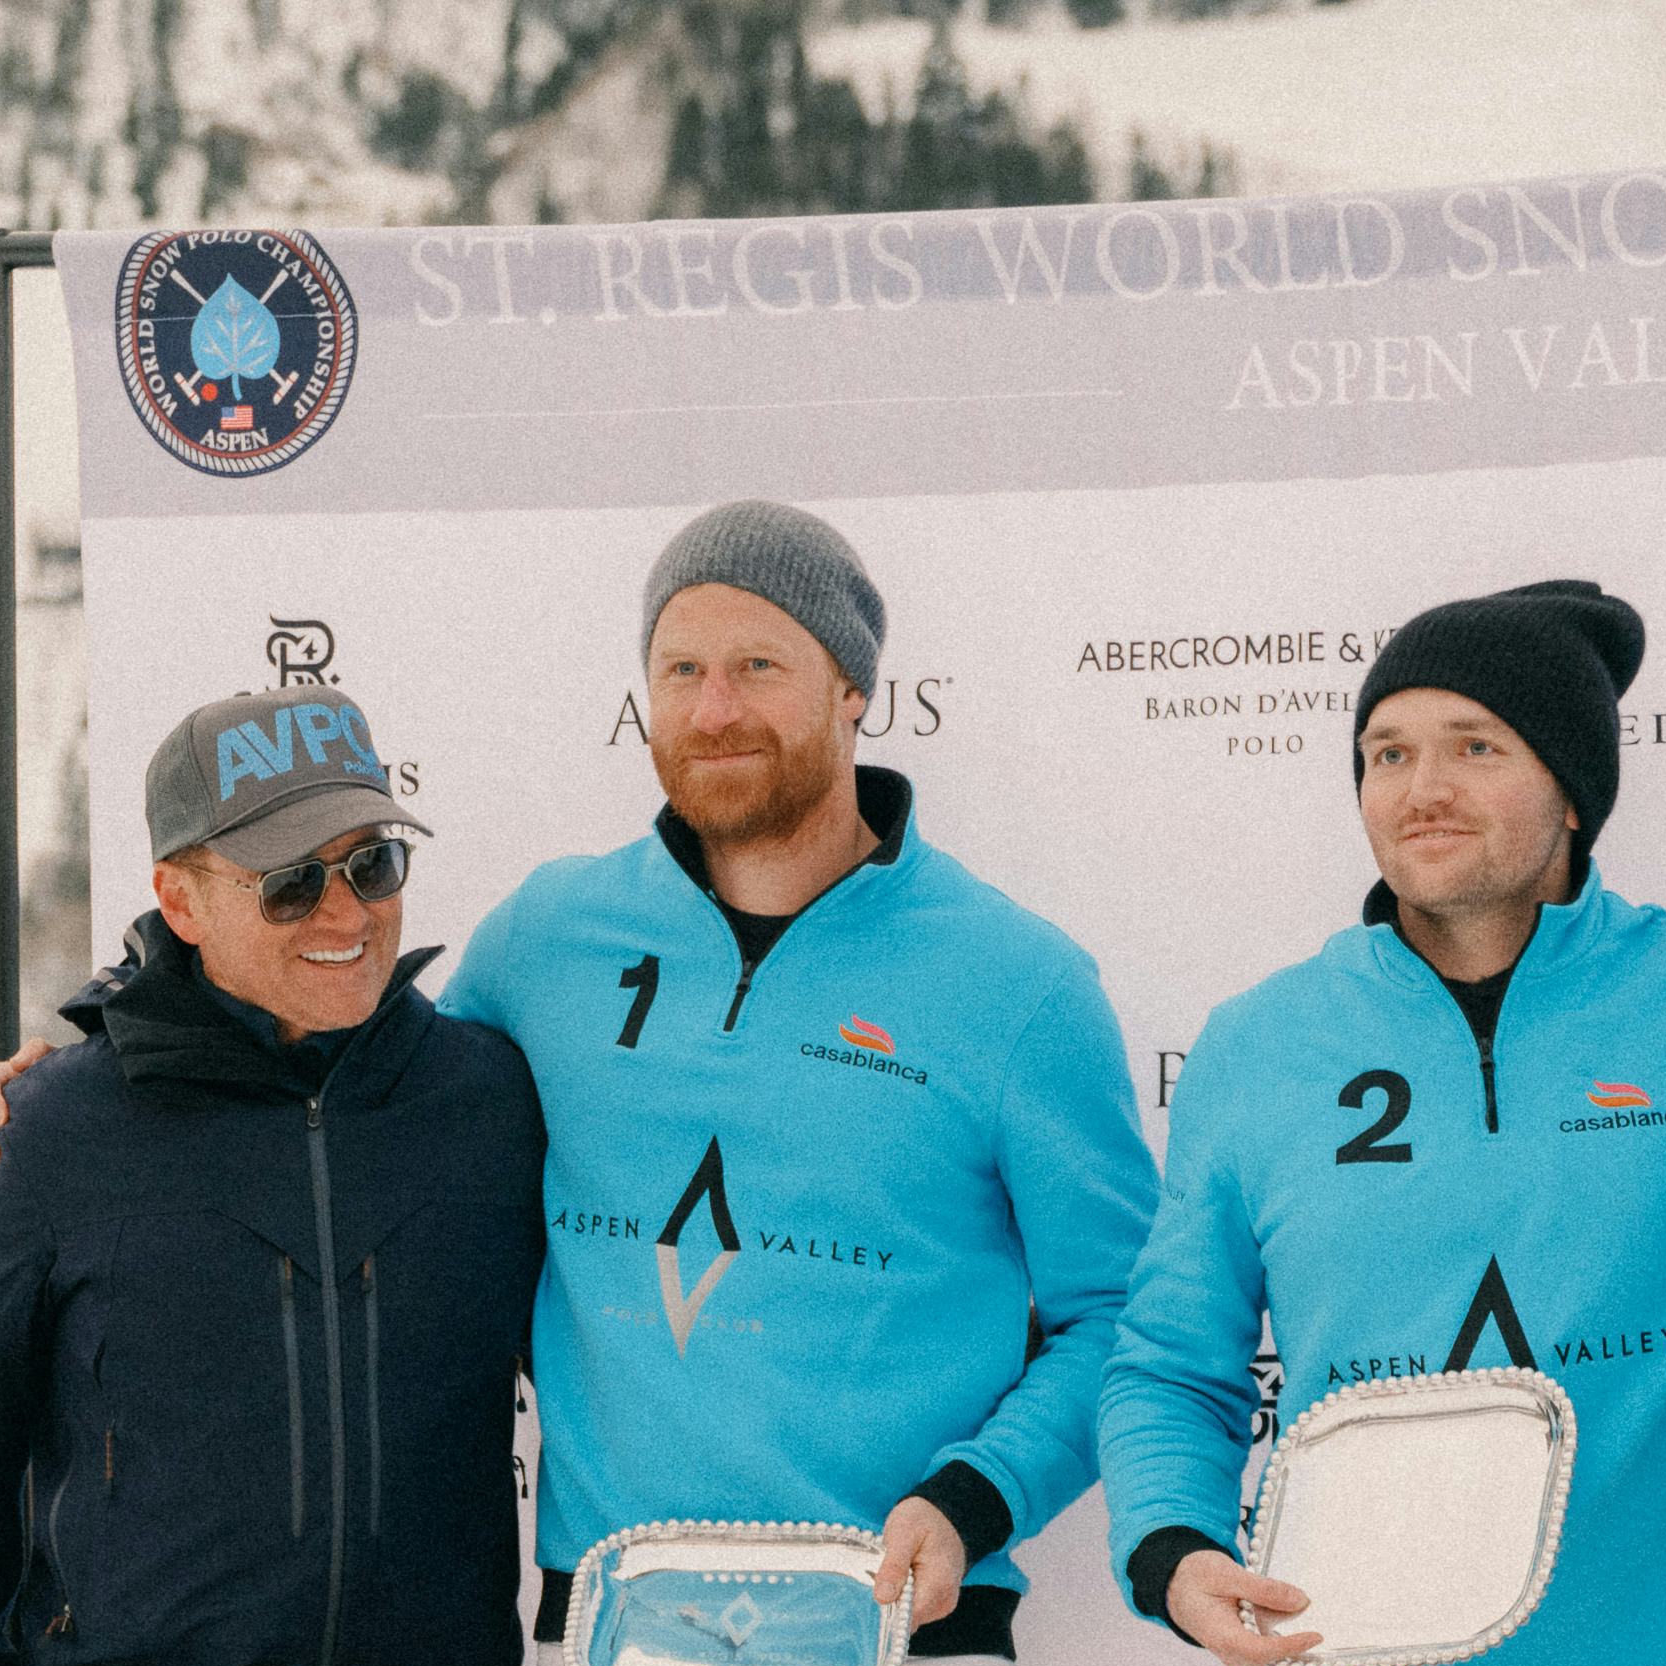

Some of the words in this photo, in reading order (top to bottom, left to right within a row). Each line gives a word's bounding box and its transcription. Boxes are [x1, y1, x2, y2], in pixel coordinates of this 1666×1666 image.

[187, 230, 252, 251] POLO
[409, 233, 557, 327] ST.
[585, 220, 925, 322] REGIS
[976, 198, 1405, 304] WORLD
[139, 241, 182, 312] SNOW
[256, 234, 335, 420] CHAMPIONSHIP
[138, 319, 178, 417] WORLD
[1228, 331, 1481, 413] ASPEN
[199, 428, 269, 451] ASPEN
[1077, 631, 1325, 672] ABERCROMBIE
[1339, 633, 1365, 663] &
[1258, 690, 1354, 714] D'AVEL
[1228, 734, 1304, 756] POLO
[616, 953, 660, 1049] 1
[799, 1042, 930, 1086] casablanca
[1336, 1069, 1413, 1165] 2
[551, 1208, 641, 1240] ASPEN
[758, 1231, 893, 1271] VALLEY
[1327, 1353, 1427, 1385] ASPEN
